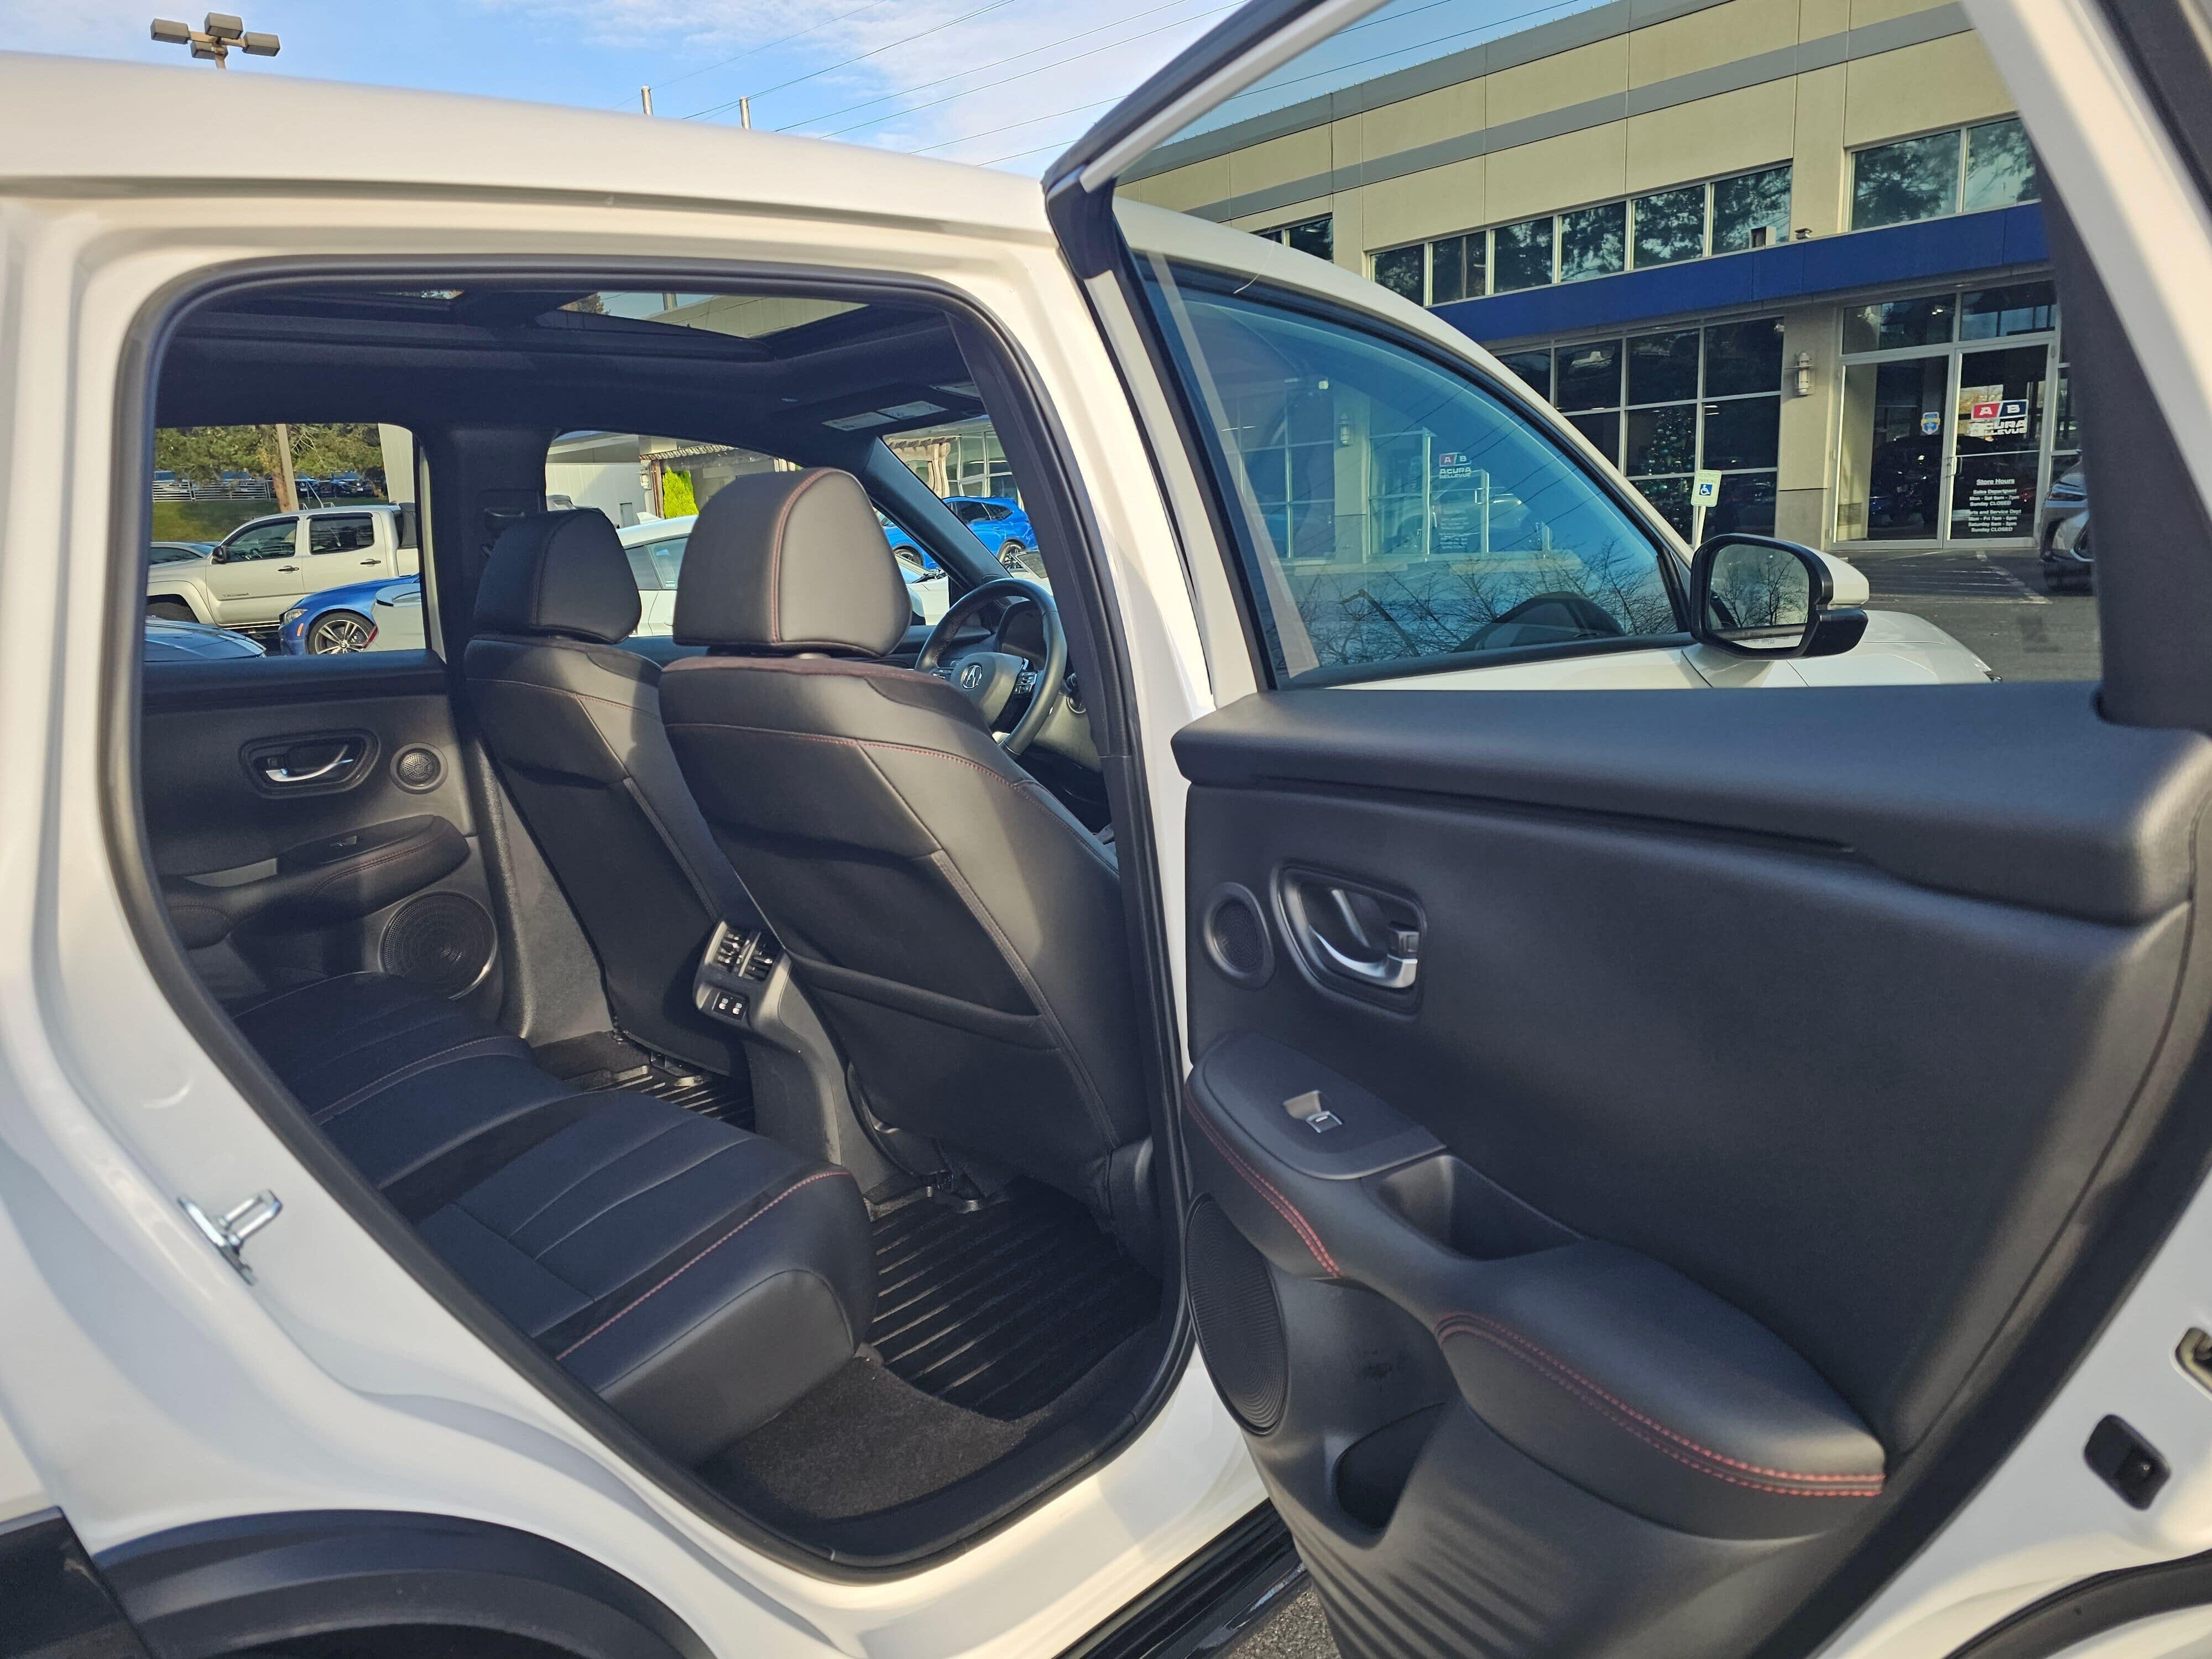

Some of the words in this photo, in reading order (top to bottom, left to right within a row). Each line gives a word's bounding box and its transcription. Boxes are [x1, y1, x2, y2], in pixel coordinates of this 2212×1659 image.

[1979, 406, 1992, 416] A
[2007, 404, 2020, 414] B
[1969, 420, 2028, 430] ACURA
